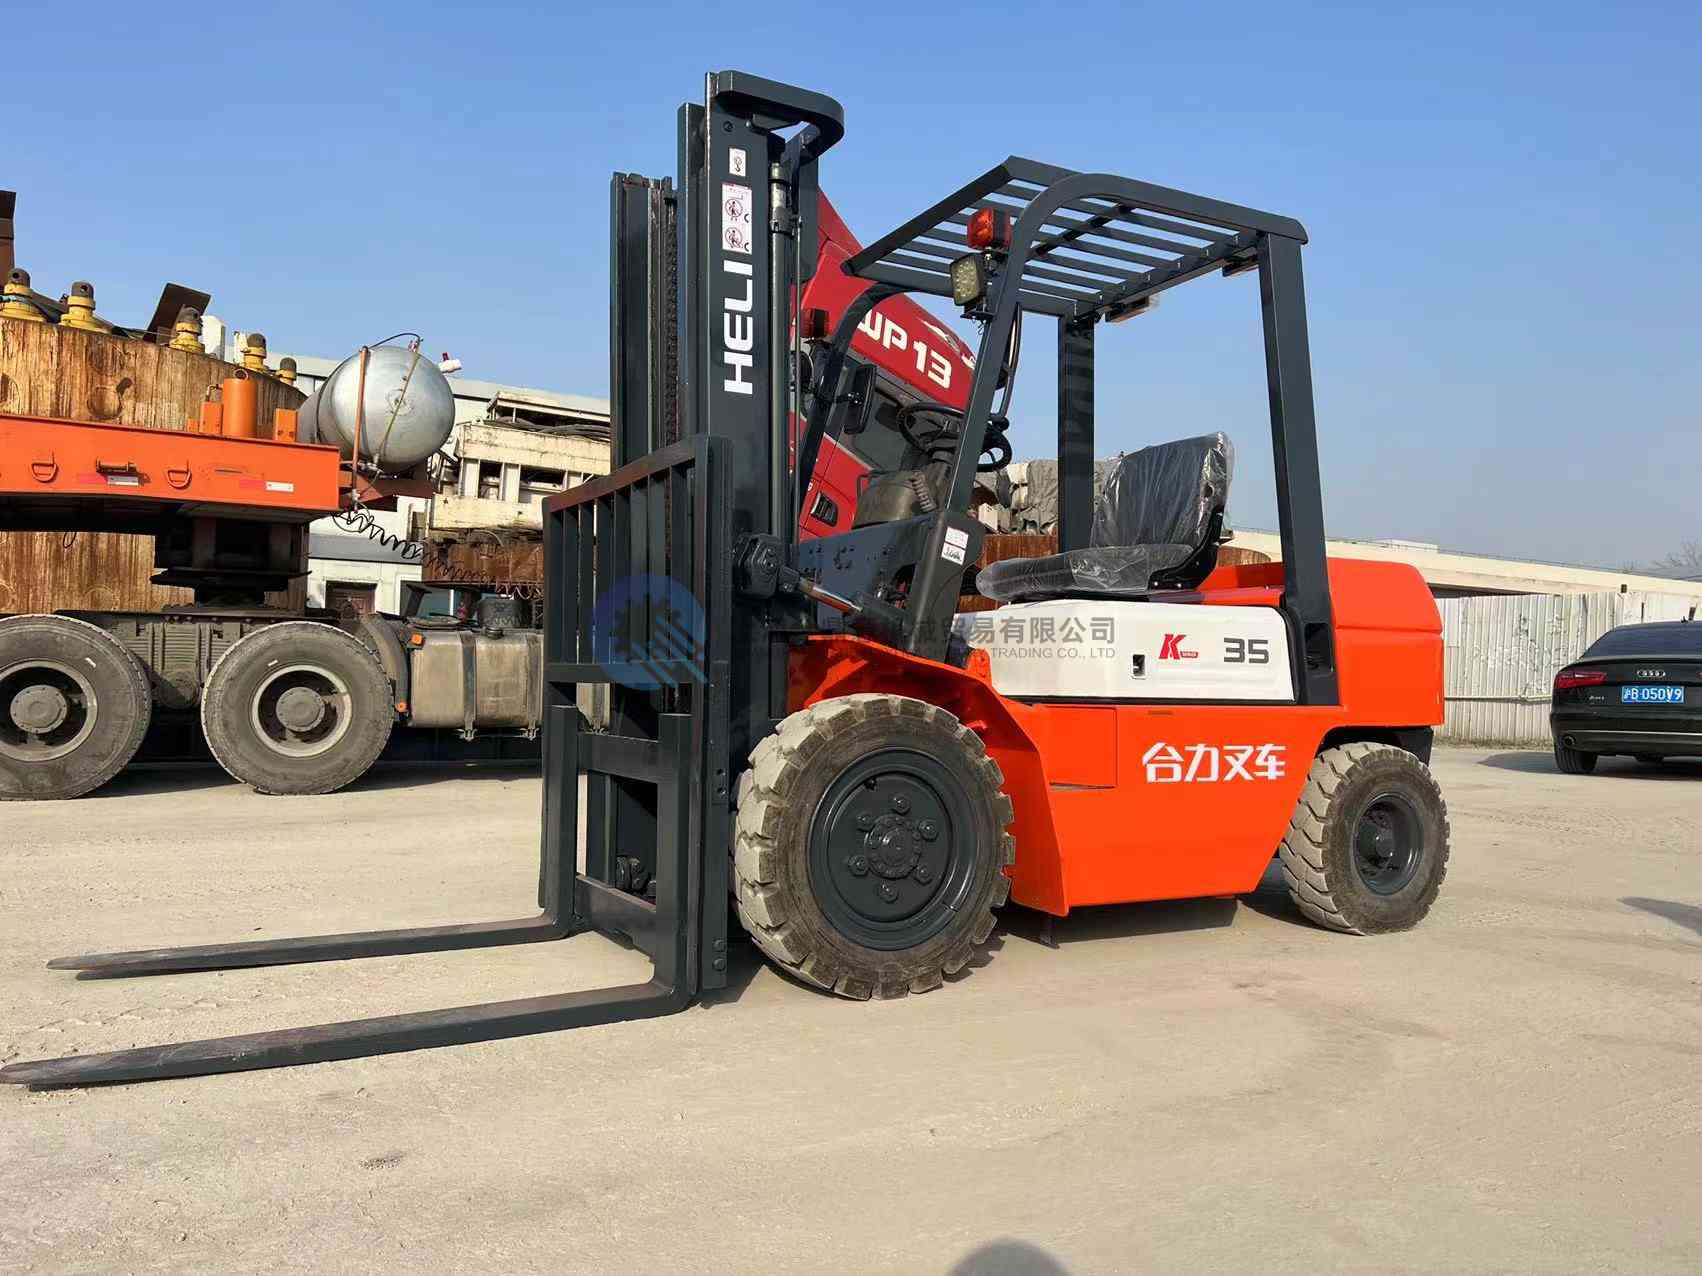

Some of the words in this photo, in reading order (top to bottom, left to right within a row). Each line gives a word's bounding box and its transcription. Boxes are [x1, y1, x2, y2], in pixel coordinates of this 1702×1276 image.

[723, 260, 753, 394] HELI
[1223, 637, 1270, 664] 35
[1141, 742, 1287, 783] 合力叉车
